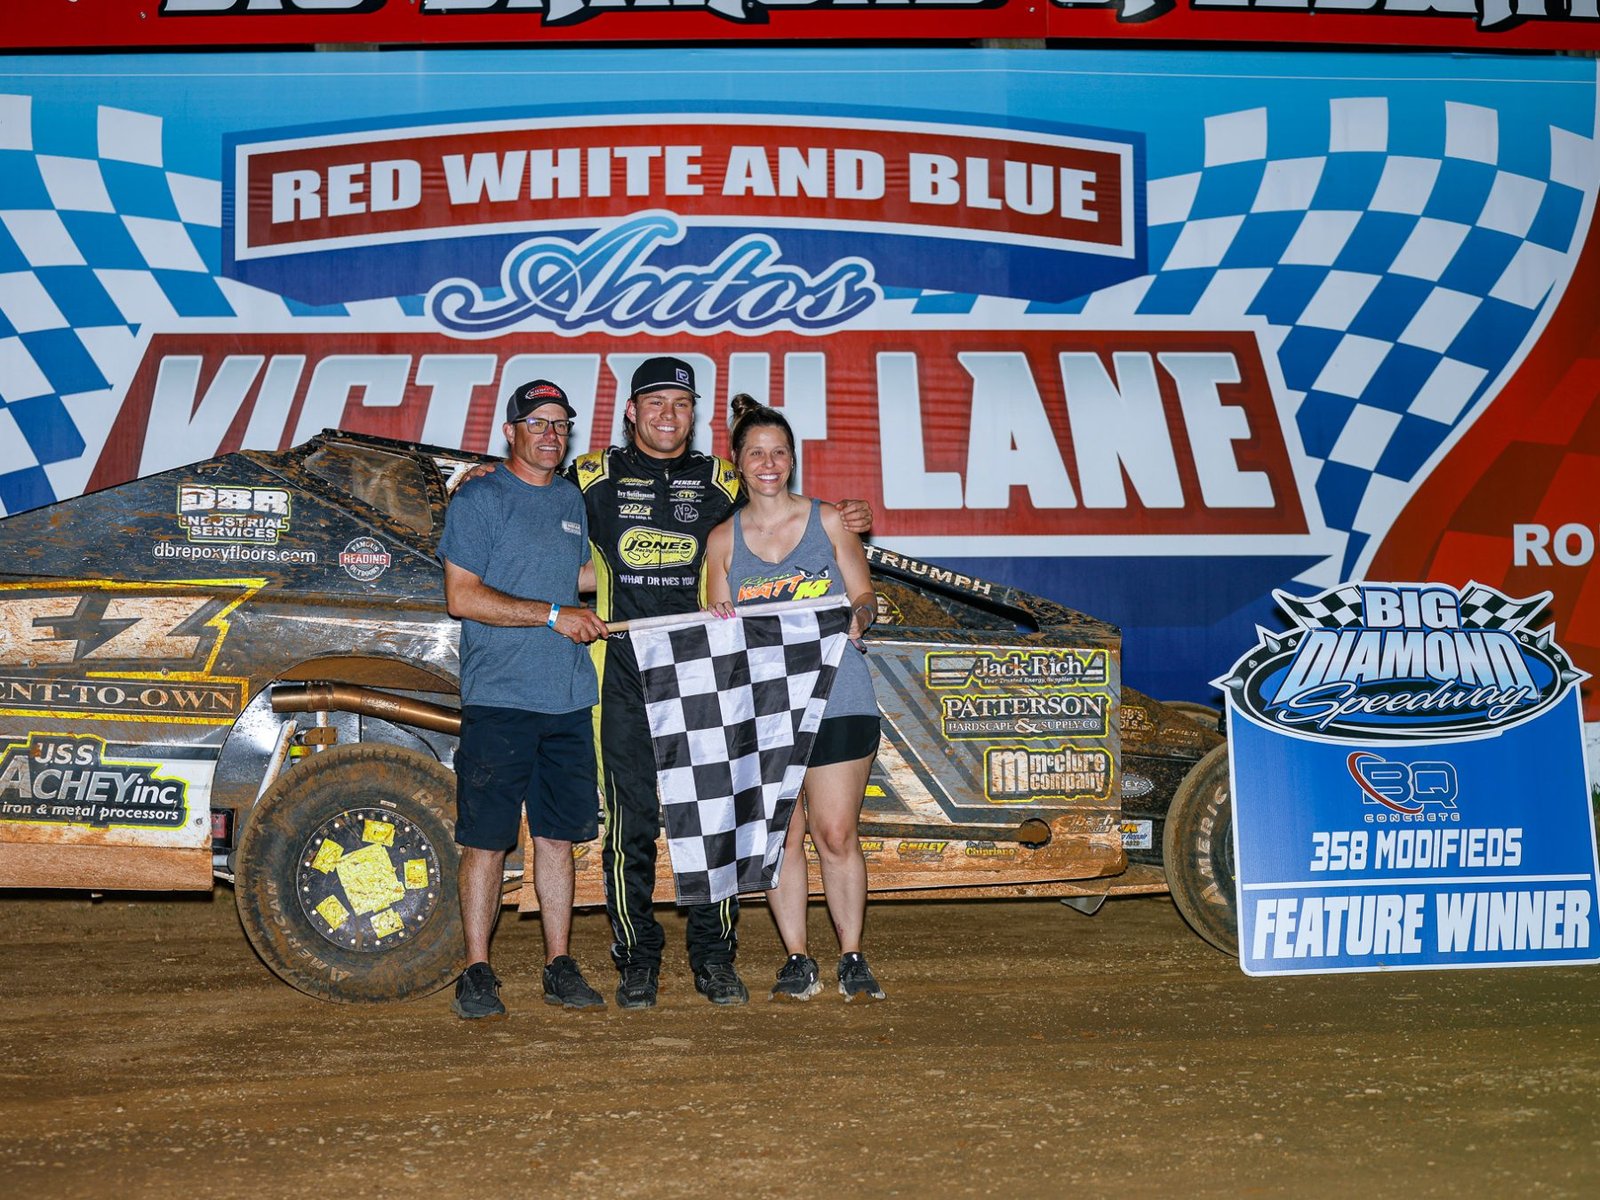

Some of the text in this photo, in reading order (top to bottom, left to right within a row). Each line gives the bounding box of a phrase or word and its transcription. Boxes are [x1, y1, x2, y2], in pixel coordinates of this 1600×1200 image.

[270, 145, 1100, 224] RED WHITE AND BLUE
[430, 211, 880, 335] Autos
[875, 351, 1276, 510] LANE
[180, 486, 288, 515] DBR
[182, 516, 288, 529] INDUSTRIAL
[190, 526, 277, 539] SERVICES
[153, 542, 317, 564] dbrepoxyfloors.com
[350, 541, 380, 552] FAMOUS
[624, 540, 692, 551] JONES
[1513, 523, 1600, 567] RO
[343, 554, 387, 565] READING
[864, 545, 992, 597] TRIUMPH
[619, 574, 645, 585] WHAT
[681, 577, 696, 586] YOU
[1366, 588, 1459, 629] BIG
[975, 654, 1083, 677] Jack Rich
[1271, 629, 1543, 706] DIAMOND
[0, 682, 237, 710] NT-TO-OWN
[944, 696, 1103, 720] PATTERSON
[1277, 679, 1532, 730] Speedway
[948, 720, 1011, 732] HARDSCAPE
[1014, 717, 1043, 734] &
[1041, 719, 1081, 730] SUPPLY
[34, 742, 95, 766] U.S.S.
[1029, 771, 1106, 792] company
[2, 801, 179, 820] iron & metal processors
[1364, 812, 1461, 823] CONCRETE
[1197, 785, 1228, 906] AMERIC
[1310, 828, 1523, 872] 358 MODIFIEDS
[1252, 890, 1592, 960] FEATURE WINNER
